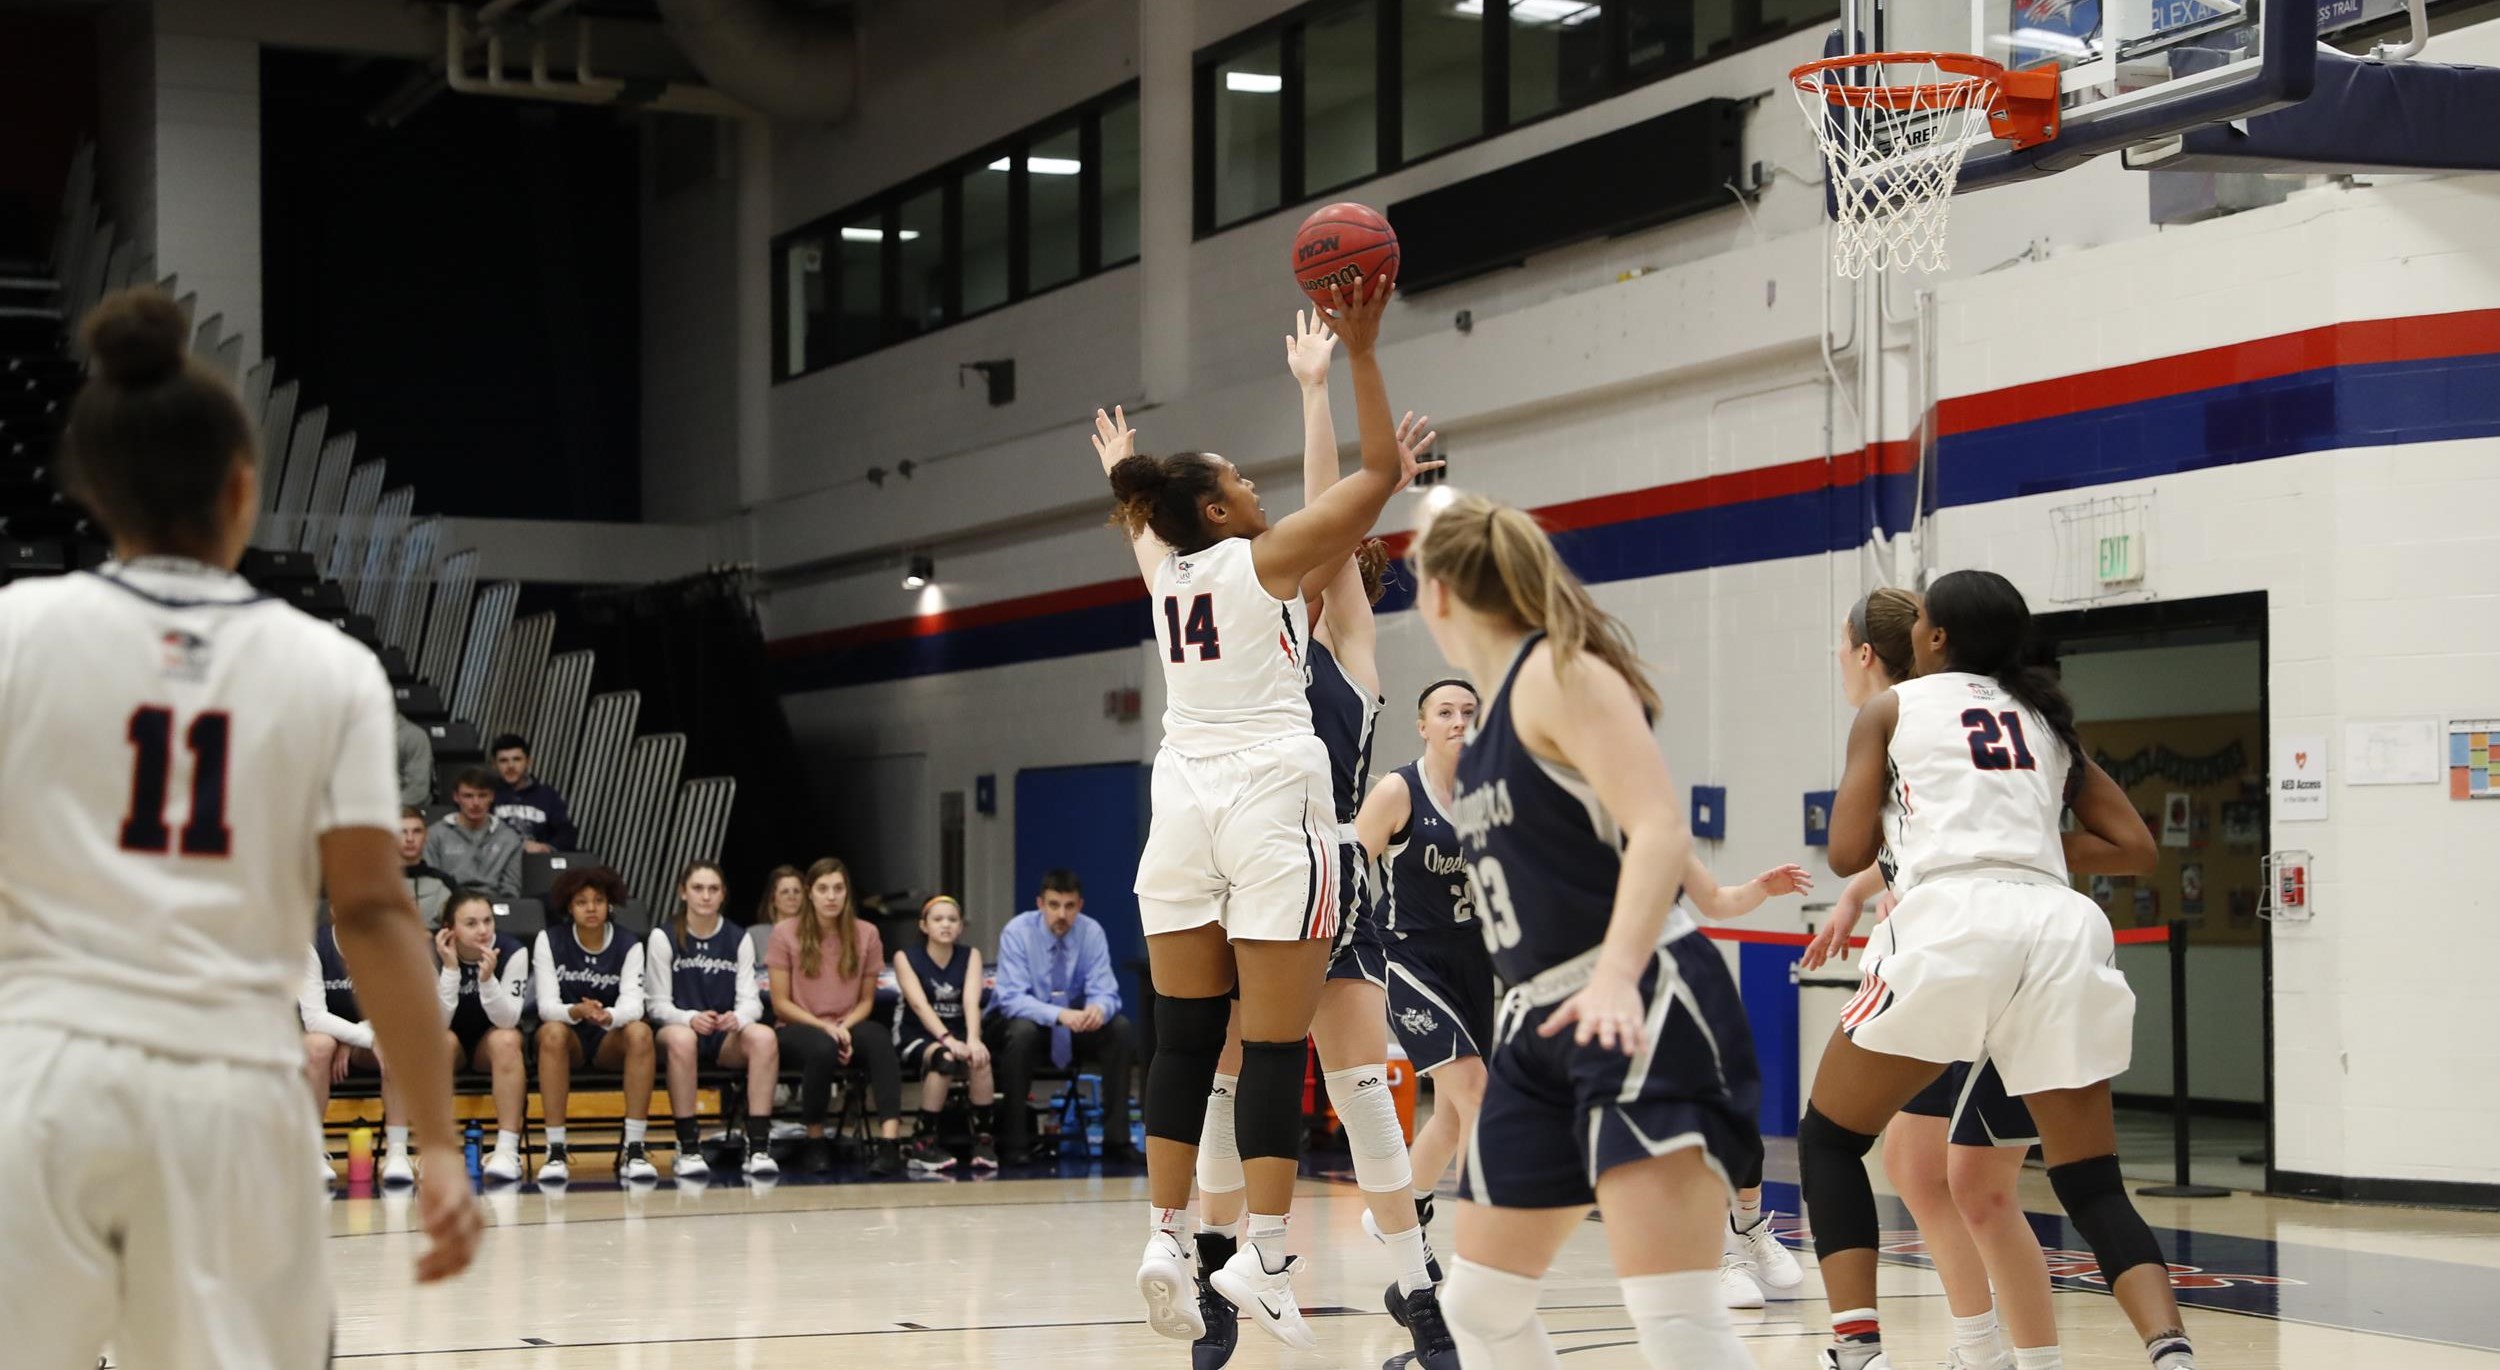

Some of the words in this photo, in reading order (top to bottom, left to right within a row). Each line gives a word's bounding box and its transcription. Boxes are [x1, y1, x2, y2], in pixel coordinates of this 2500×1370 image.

[1298, 234, 1341, 262] NCAA
[1302, 262, 1365, 292] Wilson
[2100, 535, 2128, 579] EXIT
[1164, 592, 1221, 663] 14
[1960, 707, 2036, 771] 21
[118, 702, 234, 858] 11
[2281, 779, 2295, 790] AED
[2297, 779, 2322, 790] Access
